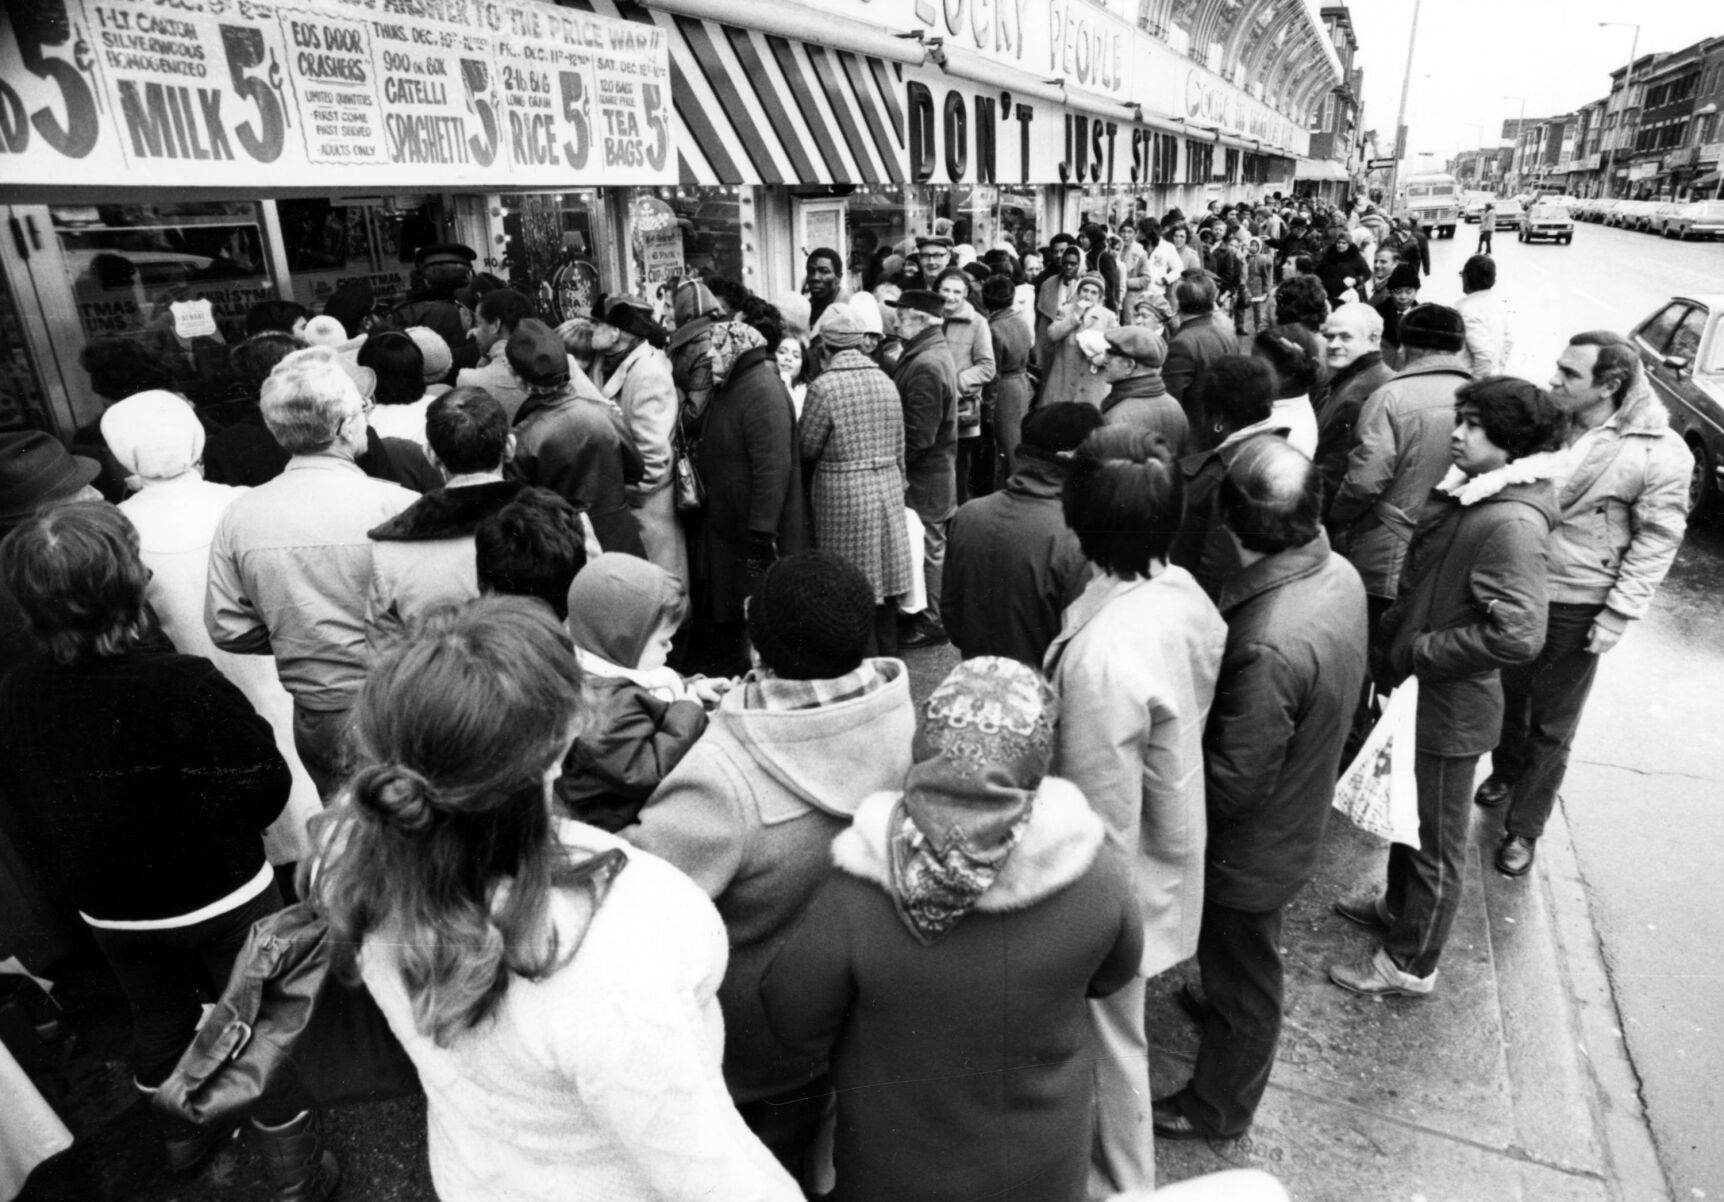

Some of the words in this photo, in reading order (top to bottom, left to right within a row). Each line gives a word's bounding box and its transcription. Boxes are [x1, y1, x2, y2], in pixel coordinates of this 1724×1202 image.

[136, 12, 198, 41] CARTON
[324, 26, 364, 54] DOOR
[506, 7, 543, 38] THE
[548, 15, 604, 48] PRICE
[1049, 0, 1121, 92] PEOPLE
[107, 51, 206, 78] HOMOGENIZED
[298, 52, 366, 82] CRASHERS
[383, 49, 411, 73] 900
[426, 56, 447, 76] BOX
[384, 76, 447, 105] CATELLI
[530, 70, 550, 94] BAG
[600, 79, 613, 93] 120
[305, 90, 333, 104] LIMITED
[506, 93, 525, 107] LONG
[117, 79, 235, 160] MILK
[313, 110, 339, 122] FIRST
[341, 112, 368, 123] COME
[603, 109, 639, 137] TEA
[316, 125, 338, 136] FIRST
[341, 126, 372, 137] SERVED
[385, 113, 469, 164] SPAGHETTI
[509, 109, 560, 166] RICE
[907, 80, 1033, 184] DON'T
[1059, 113, 1117, 184] JUST
[1130, 127, 1178, 183] STAND
[320, 144, 351, 156] ADULTS
[353, 145, 376, 156] ONLY
[604, 137, 644, 167] BAGS
